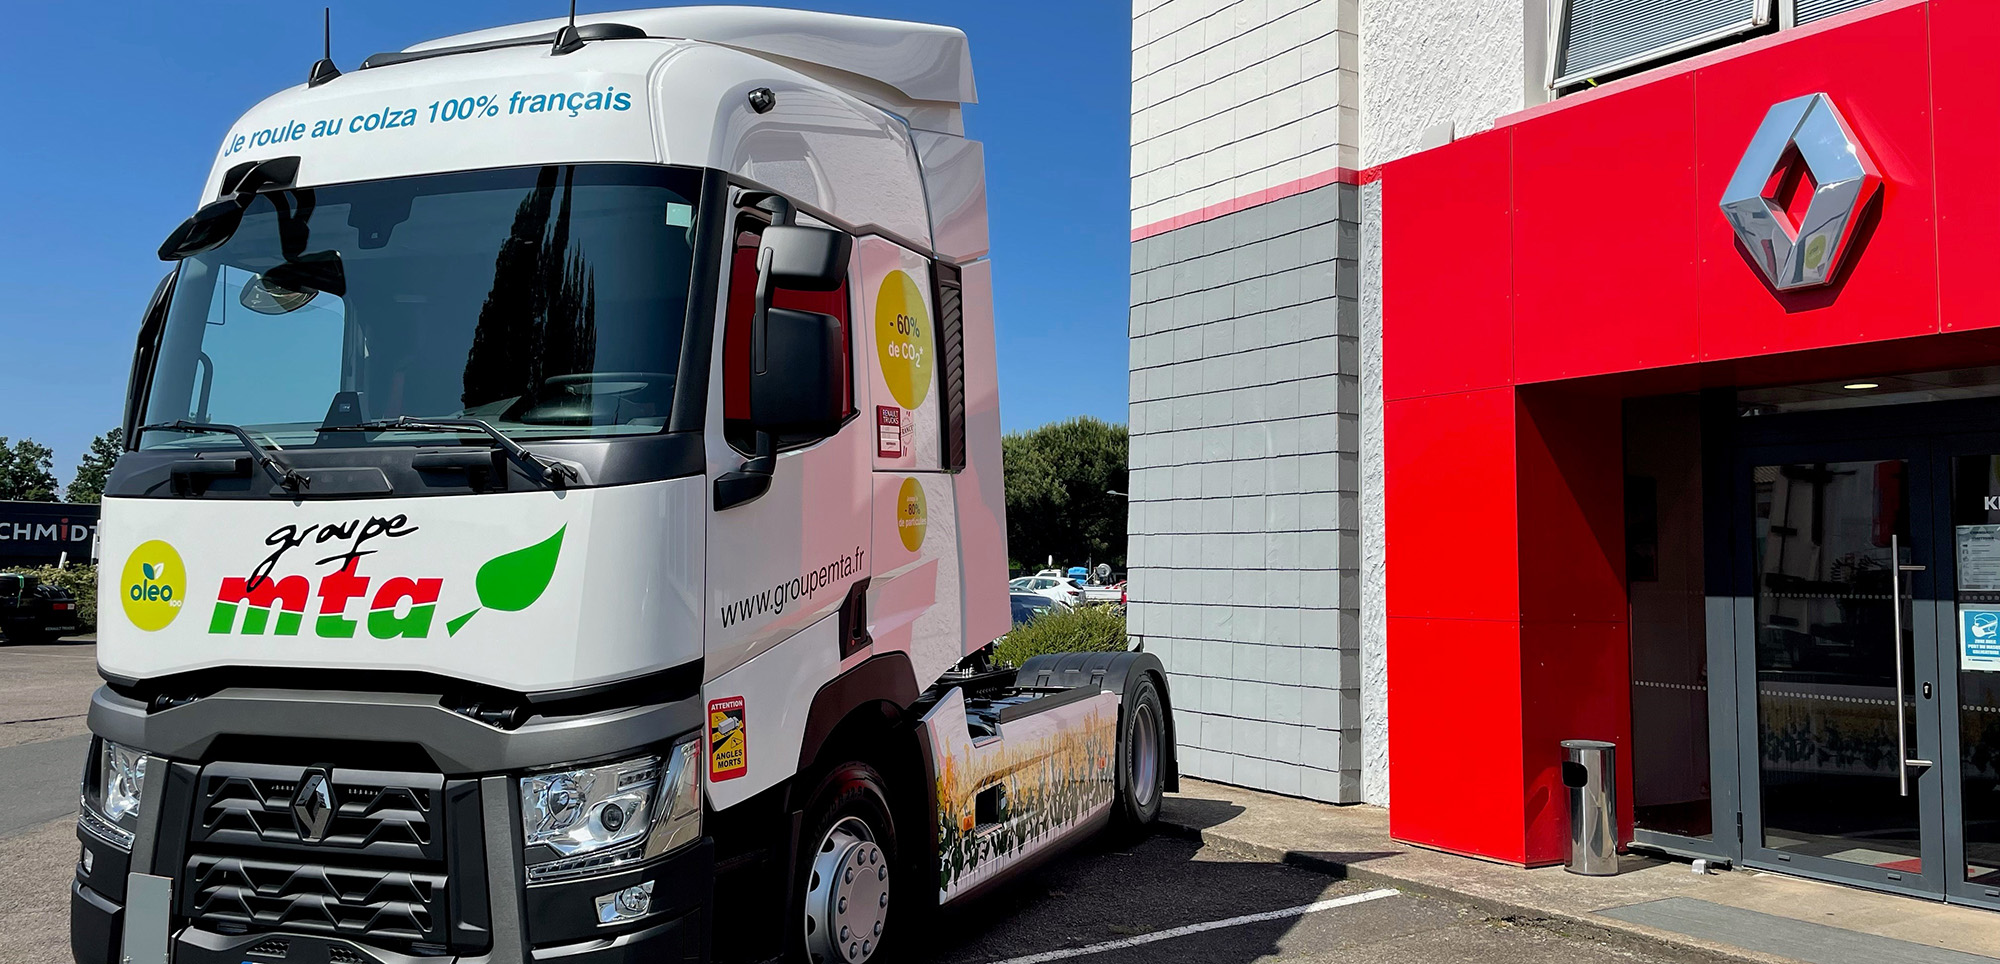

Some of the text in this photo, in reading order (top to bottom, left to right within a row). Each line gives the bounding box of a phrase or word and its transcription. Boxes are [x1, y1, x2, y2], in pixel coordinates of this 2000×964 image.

[224, 86, 632, 157] Je roule au colza 100% français
[897, 313, 921, 338] 60%
[888, 340, 900, 357] de
[246, 513, 420, 592] groupe
[130, 579, 173, 602] oleo
[208, 556, 444, 639] mta
[721, 546, 865, 629] www.groupemta.fr
[711, 700, 743, 711] ATTENTION
[716, 749, 742, 761] ANGLES
[718, 757, 741, 769] MORTS
